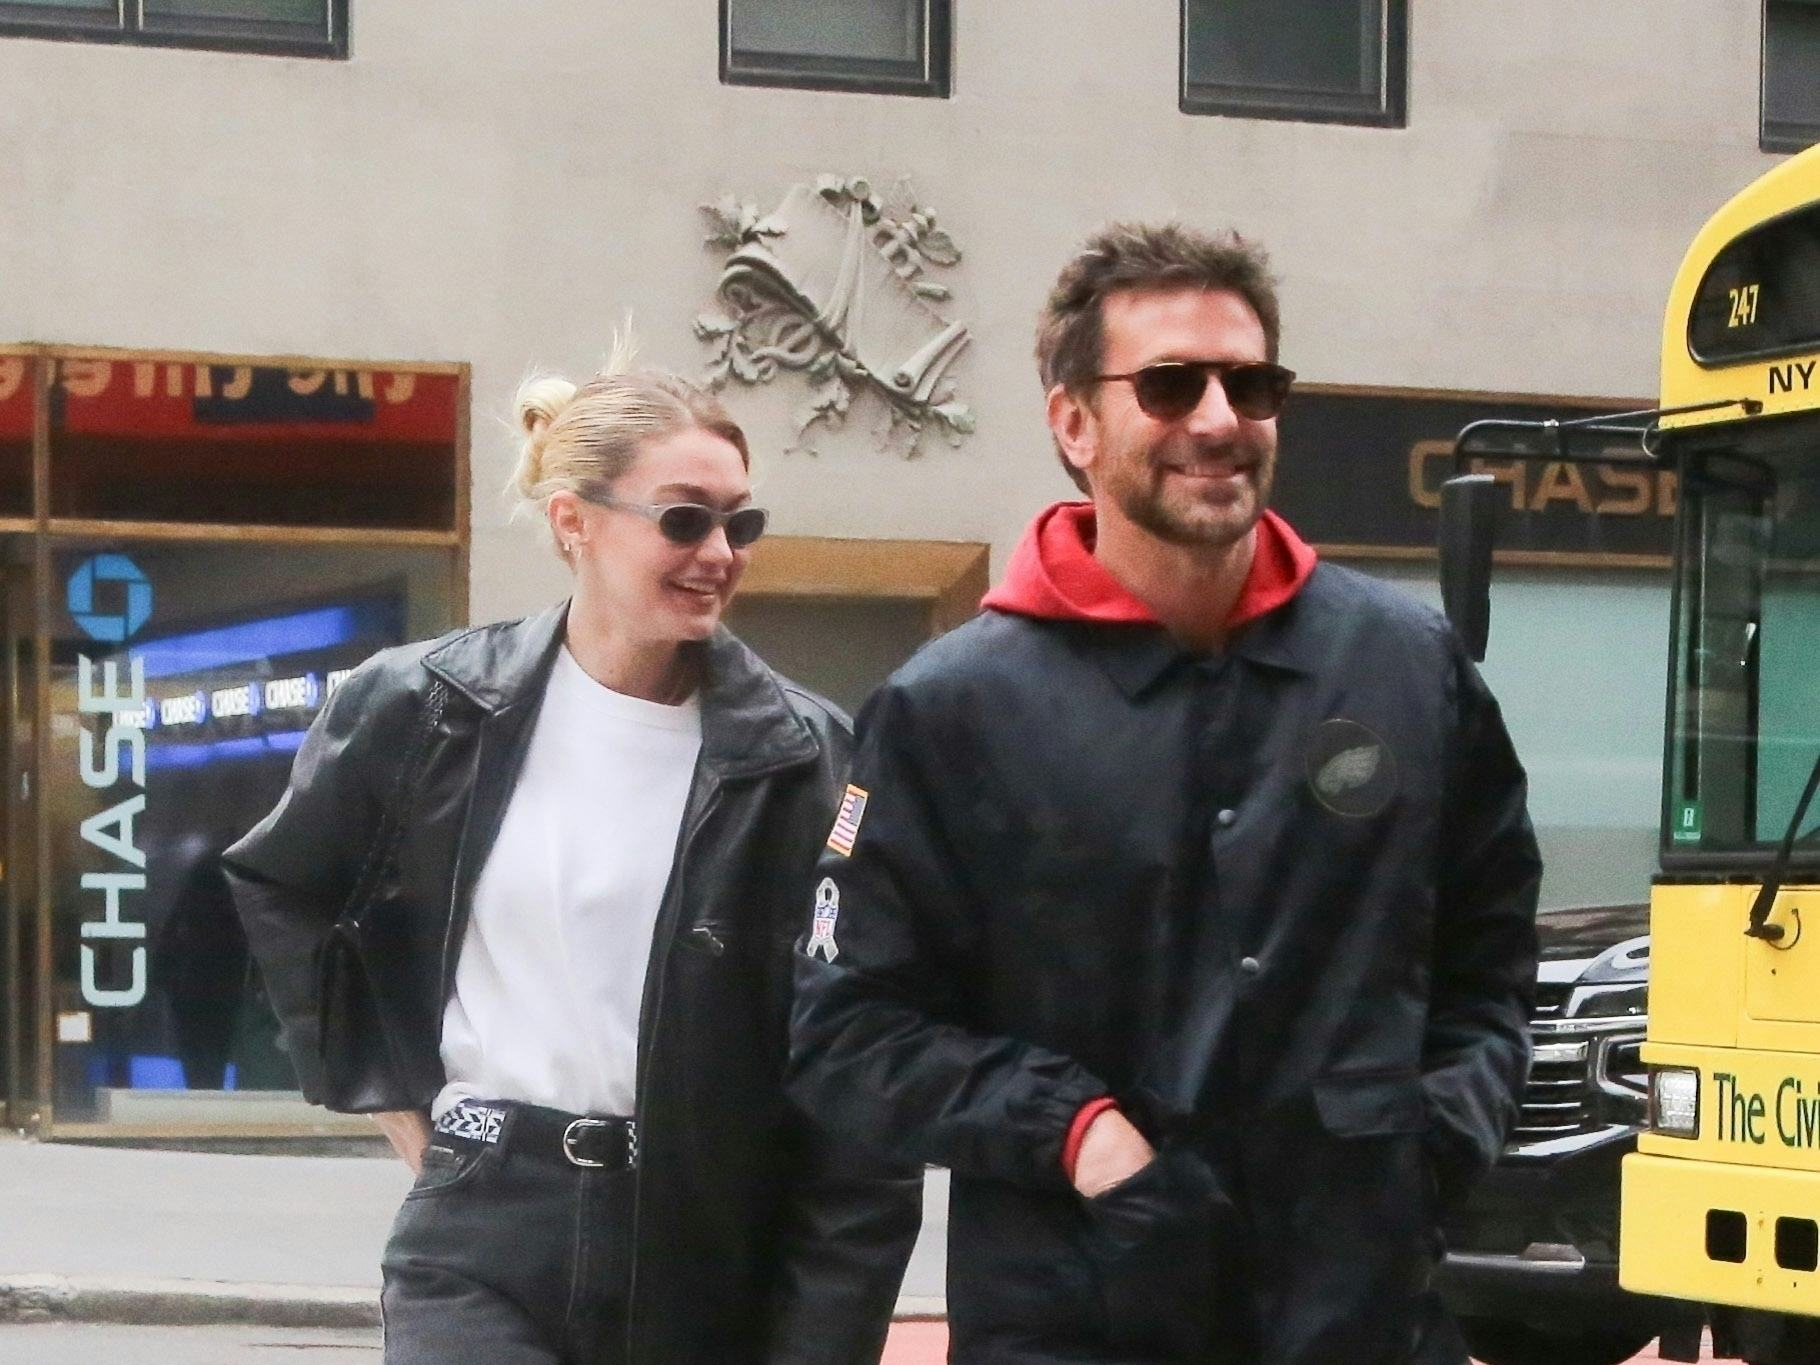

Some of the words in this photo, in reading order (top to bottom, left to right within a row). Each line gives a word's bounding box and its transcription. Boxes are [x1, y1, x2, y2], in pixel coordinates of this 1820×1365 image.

[1727, 284, 1759, 328] 247
[1769, 360, 1816, 394] NY
[78, 653, 147, 1008] CHASE
[1713, 1072, 1765, 1145] The
